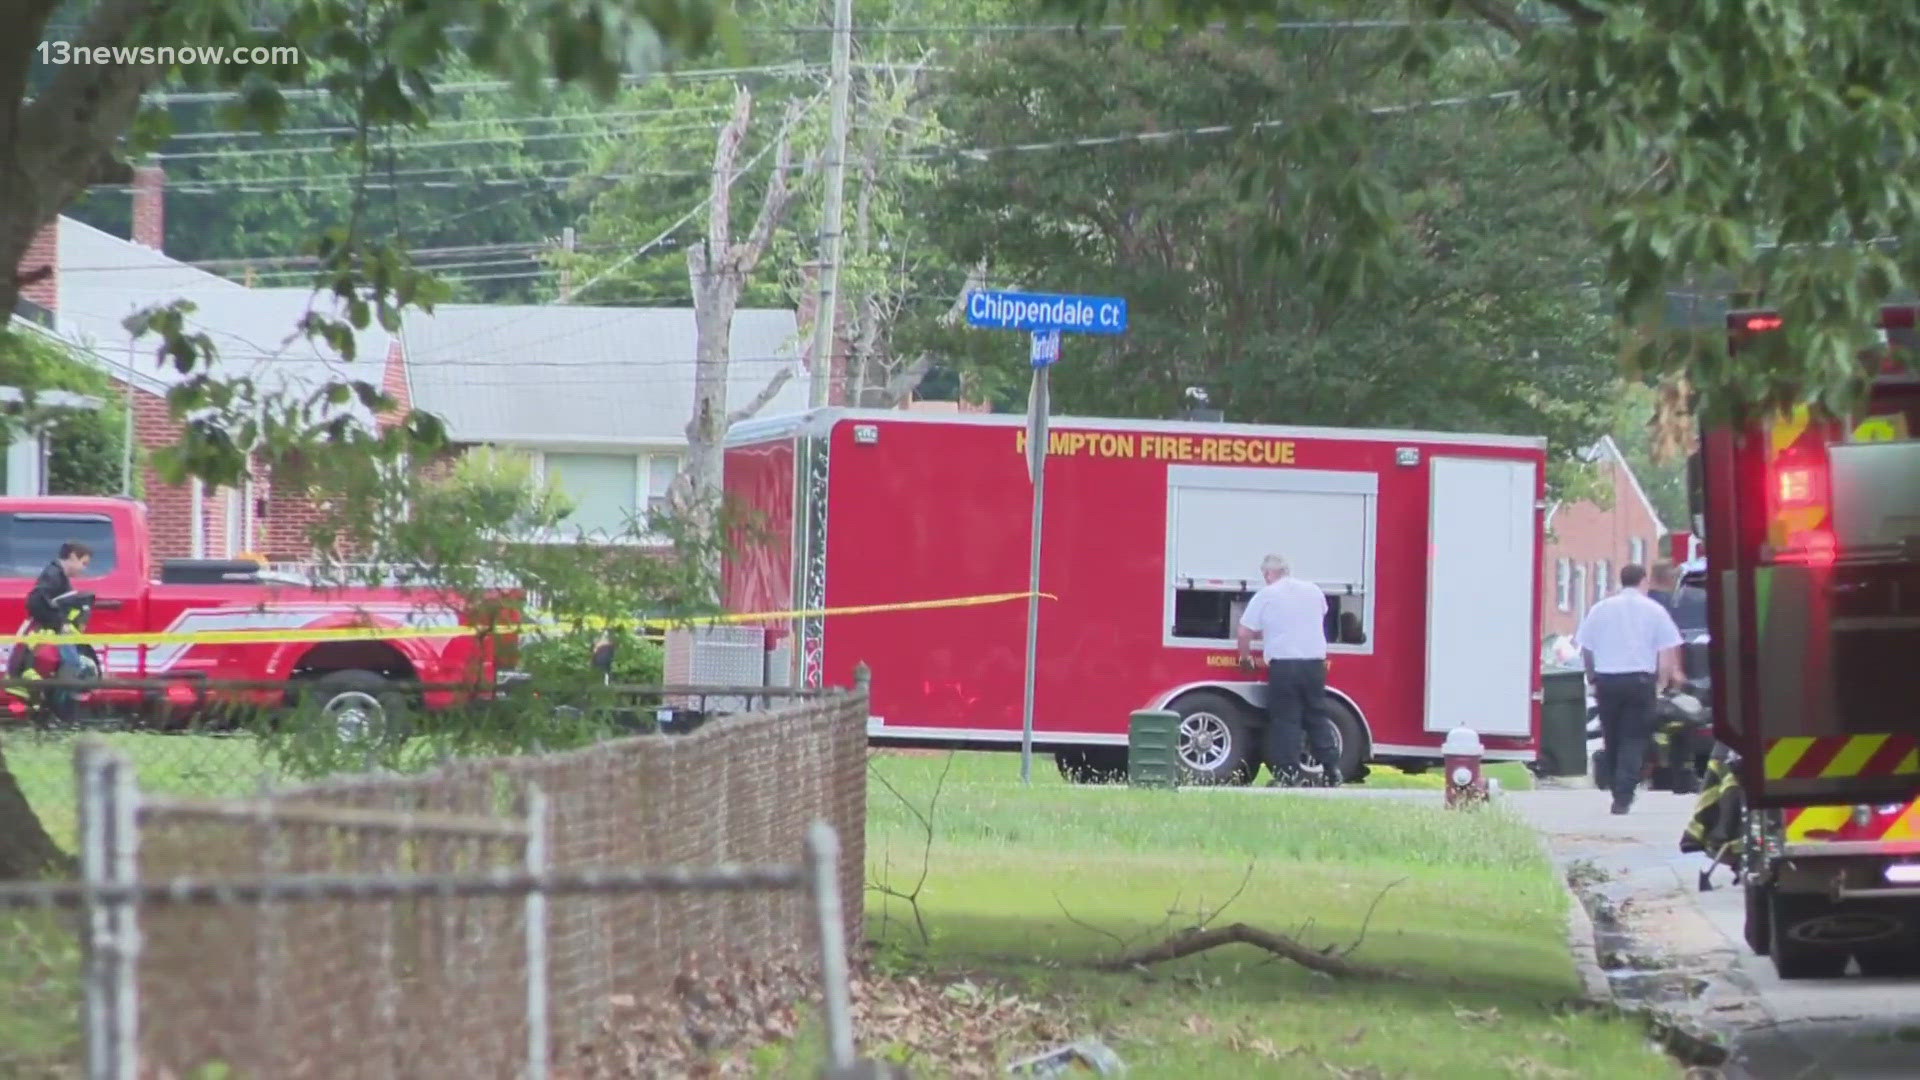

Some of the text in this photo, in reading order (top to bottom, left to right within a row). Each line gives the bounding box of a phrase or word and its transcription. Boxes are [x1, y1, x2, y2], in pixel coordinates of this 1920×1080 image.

[970, 293, 1120, 327] Chippendale Ct
[1016, 430, 1296, 464] HMPTON FIRE-RESCUE
